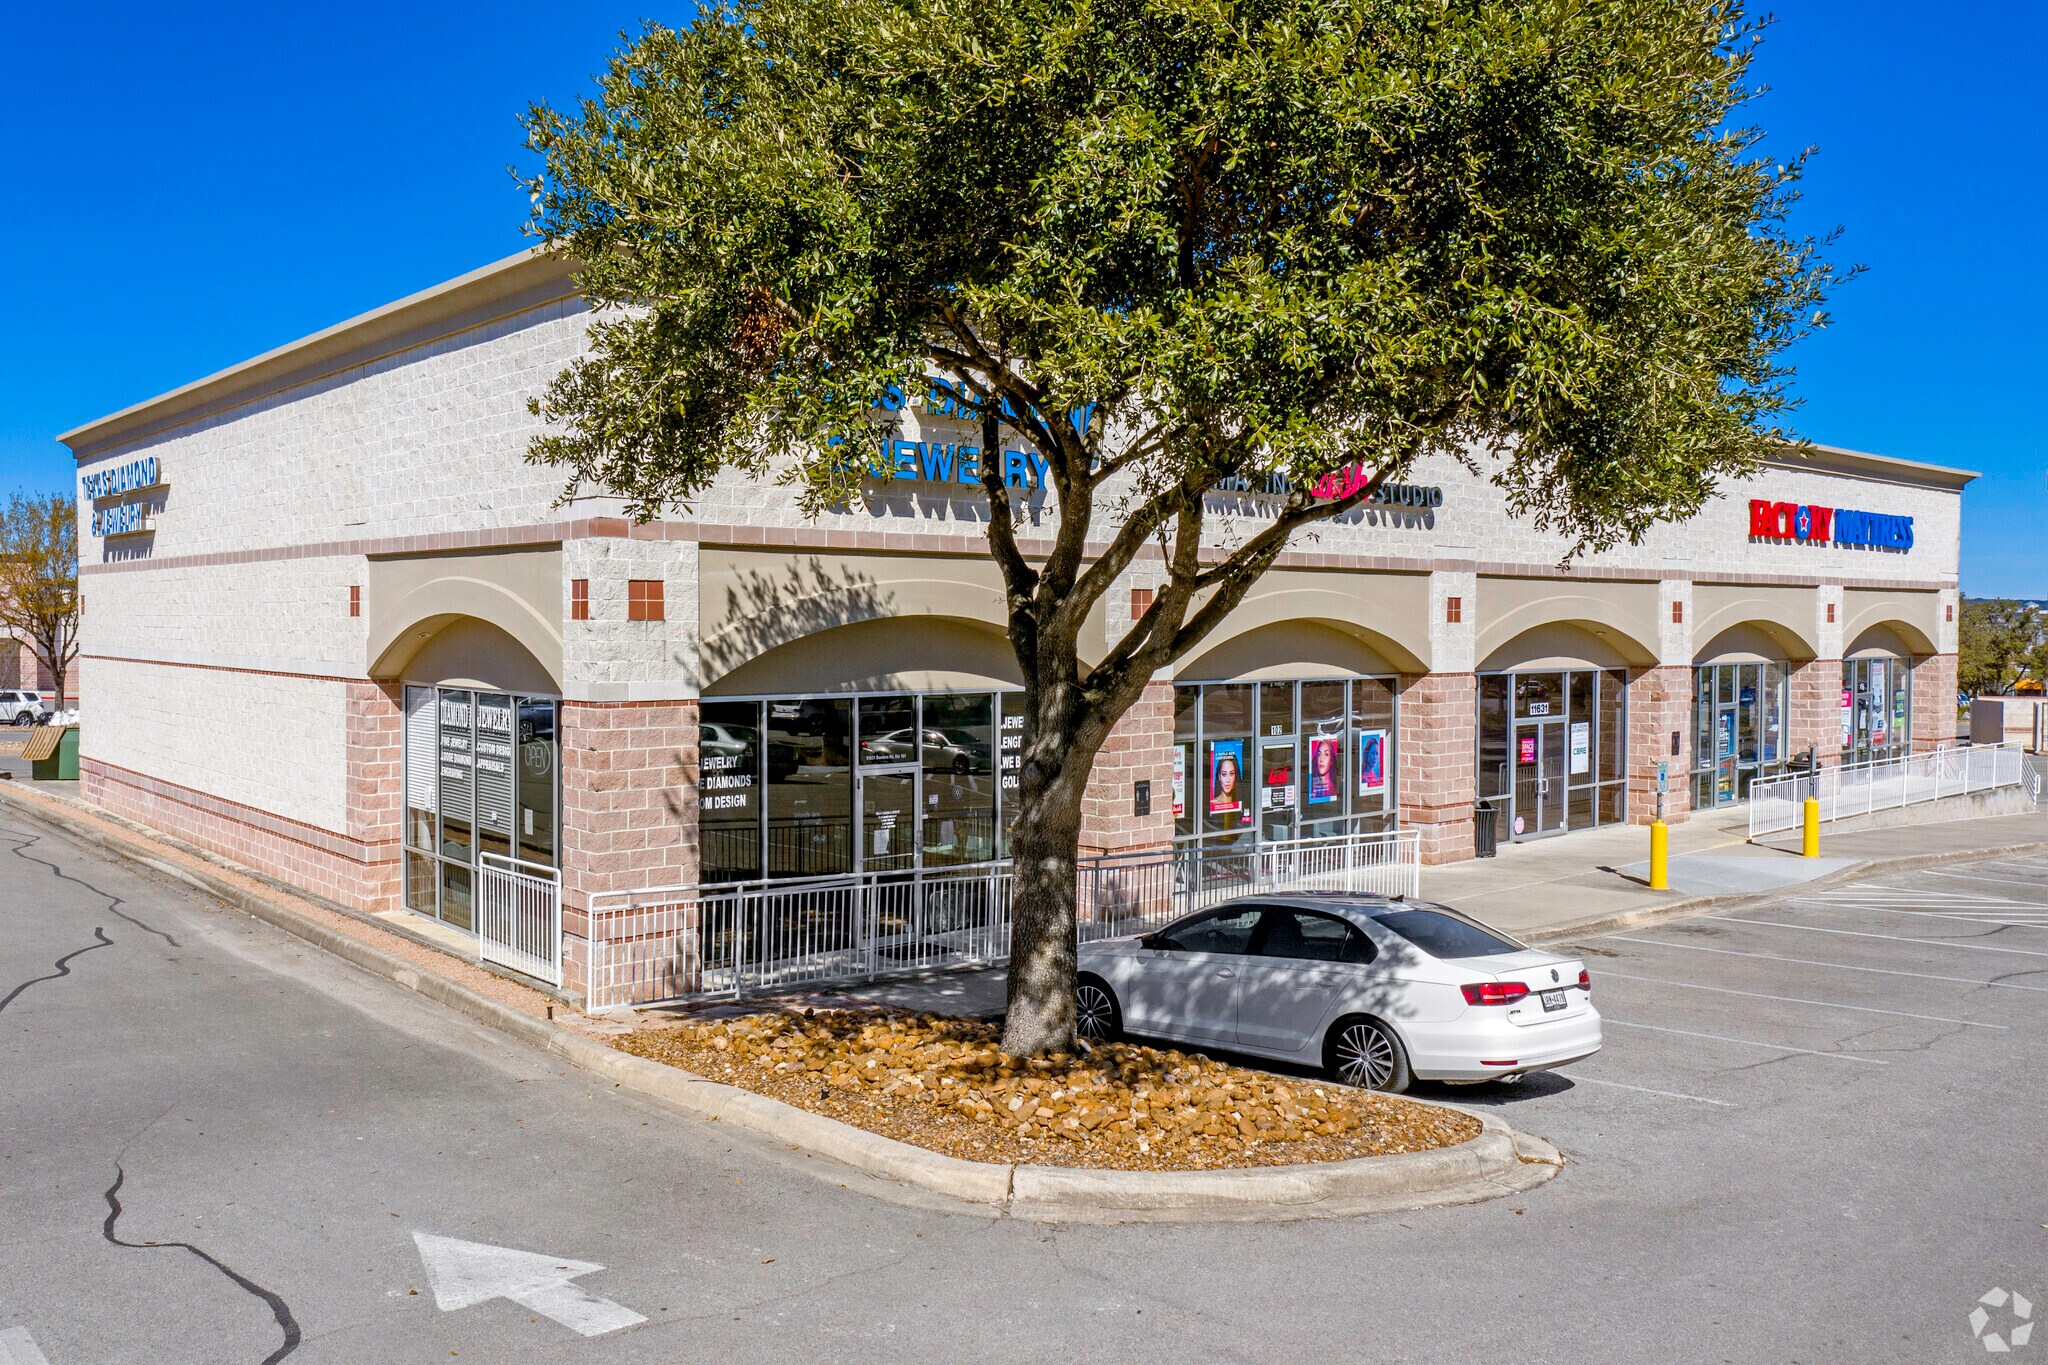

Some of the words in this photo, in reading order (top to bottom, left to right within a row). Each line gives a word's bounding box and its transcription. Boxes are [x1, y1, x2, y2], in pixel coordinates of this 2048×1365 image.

[868, 438, 1049, 490] JEWERY
[82, 469, 110, 501] TEXAS
[111, 456, 158, 495] DIAMOND
[1375, 482, 1443, 507] STUDIO
[102, 502, 142, 536] JEWELRY
[1749, 498, 1834, 541] FACTORY
[1834, 508, 1914, 549] MATTRESS
[1531, 704, 1548, 713] 11631
[1003, 716, 1024, 729] JEWE
[1573, 746, 1587, 755] CBRE
[706, 774, 752, 789] DIAMONDS
[714, 794, 746, 809] DESIGN
